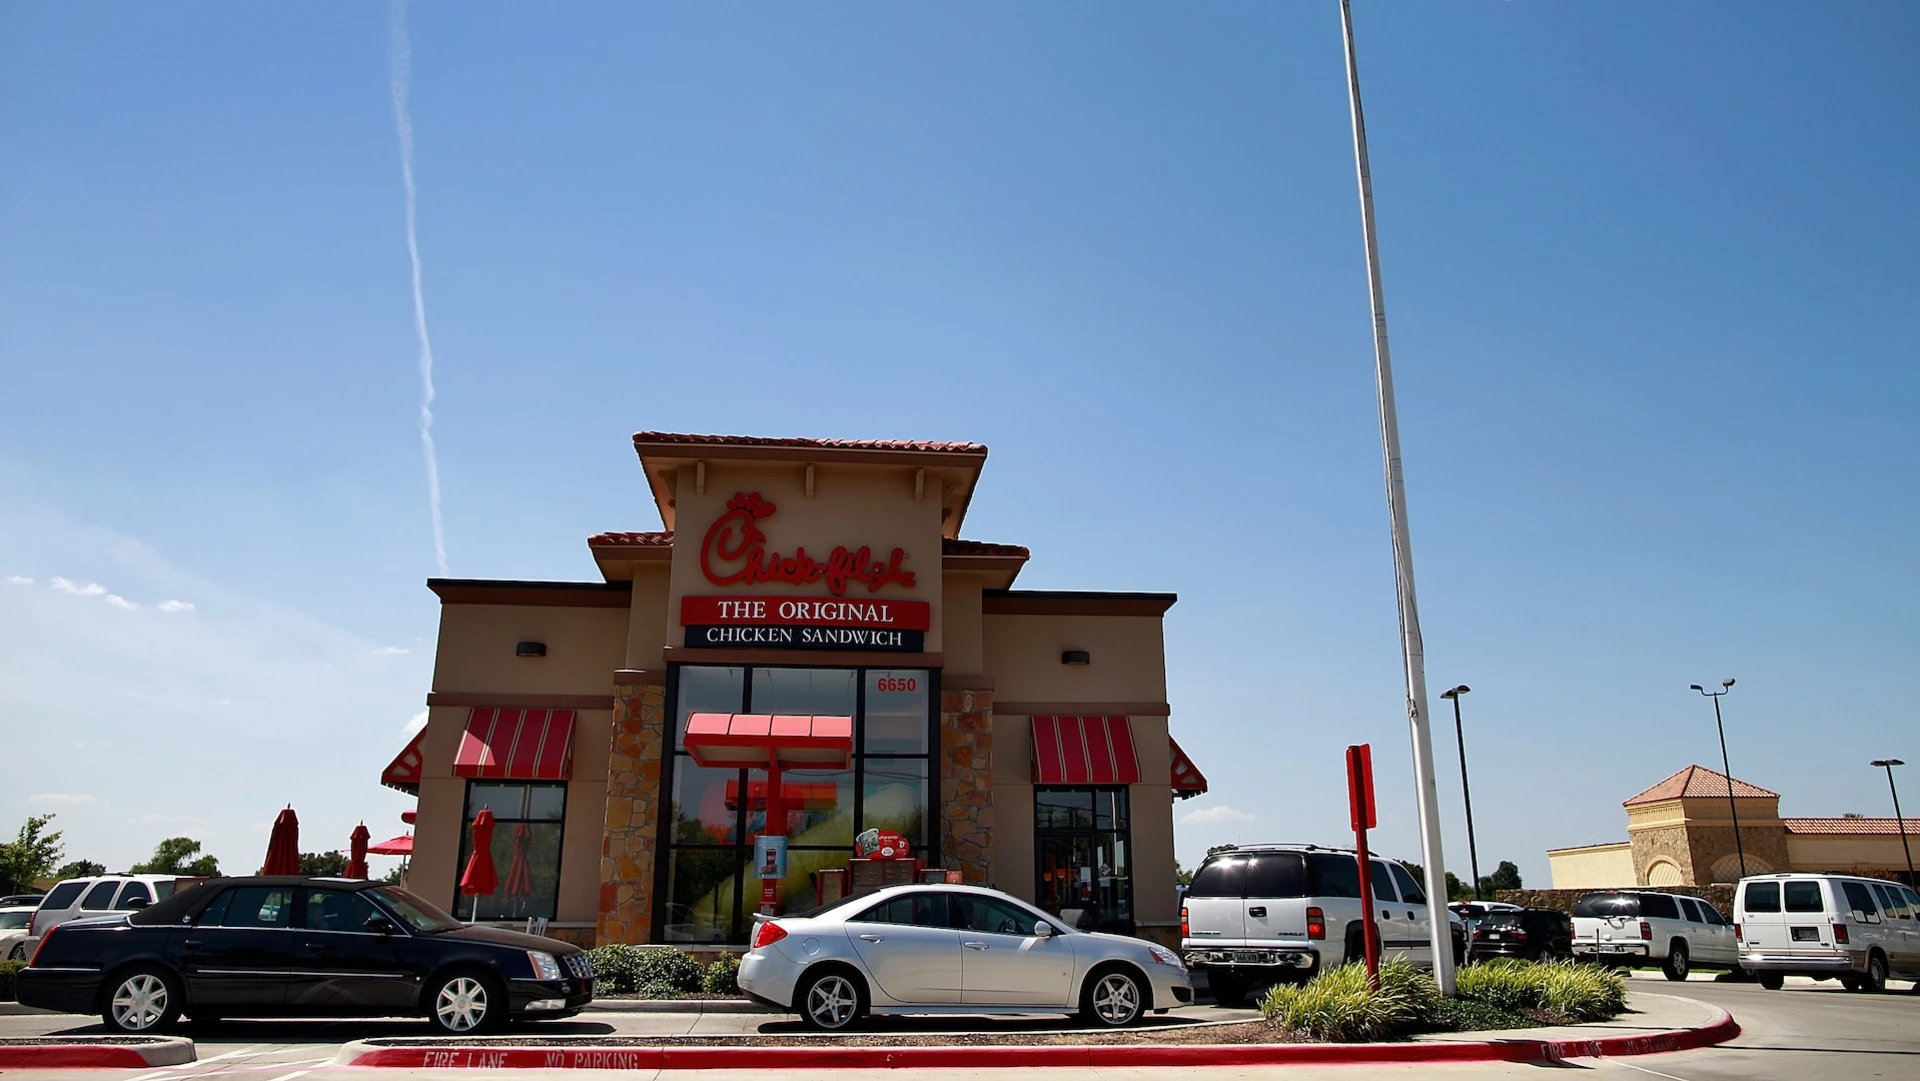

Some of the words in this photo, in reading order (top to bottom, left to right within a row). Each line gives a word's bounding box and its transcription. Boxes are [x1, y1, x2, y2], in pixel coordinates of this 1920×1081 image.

[701, 493, 917, 597] Chick-fil-A
[718, 601, 766, 619] THE
[779, 601, 894, 623] ORIGINAL
[706, 627, 792, 643] CHICKEN
[802, 628, 902, 646] SANDWICH
[877, 677, 916, 692] 6650
[423, 1051, 460, 1067] FIRE
[467, 1052, 509, 1068] LANE
[1540, 1043, 1567, 1060] FIRE
[544, 1052, 565, 1067] NO
[573, 1052, 638, 1069] PARKING
